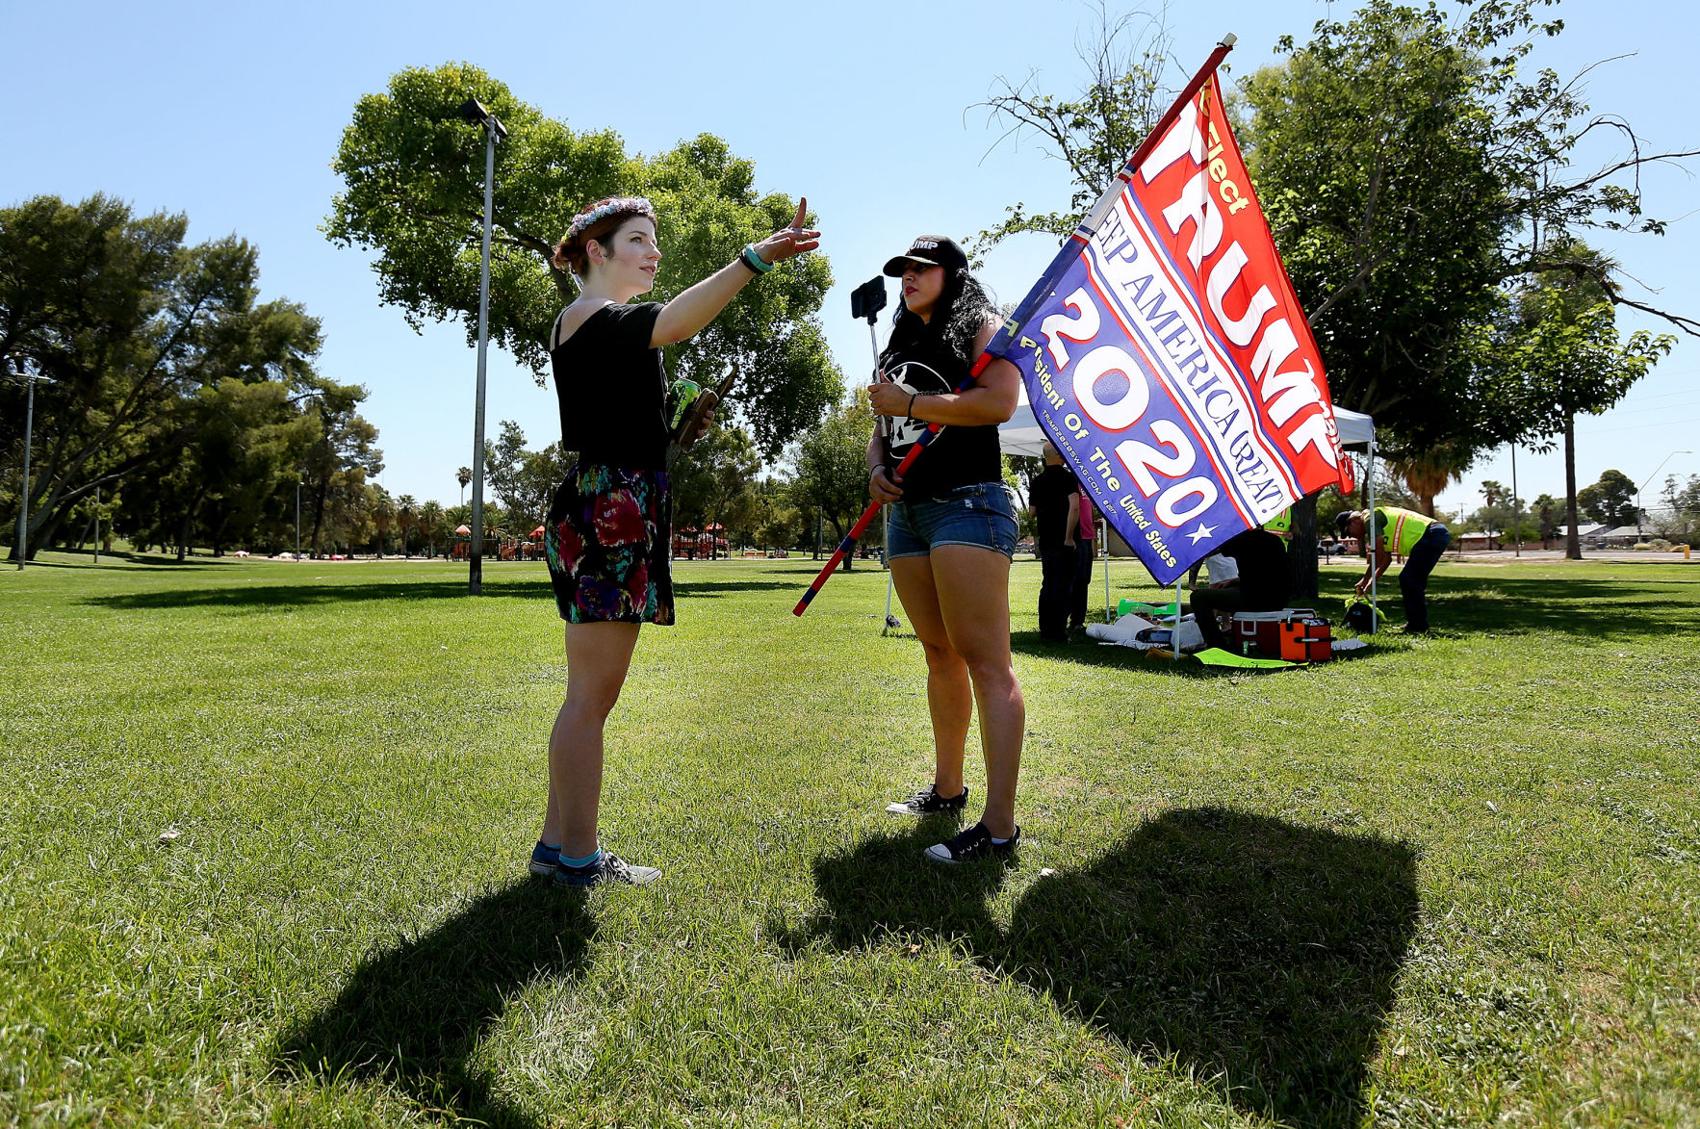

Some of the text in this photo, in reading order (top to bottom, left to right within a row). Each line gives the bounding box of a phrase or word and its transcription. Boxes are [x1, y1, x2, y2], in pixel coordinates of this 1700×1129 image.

[910, 240, 939, 250] UMP
[1098, 207, 1138, 265] EEP
[1121, 274, 1240, 440] AMERICA
[1140, 99, 1338, 470] TRUMP
[1019, 335, 1177, 569] Prsident Of The United States
[1041, 286, 1218, 528] 2020
